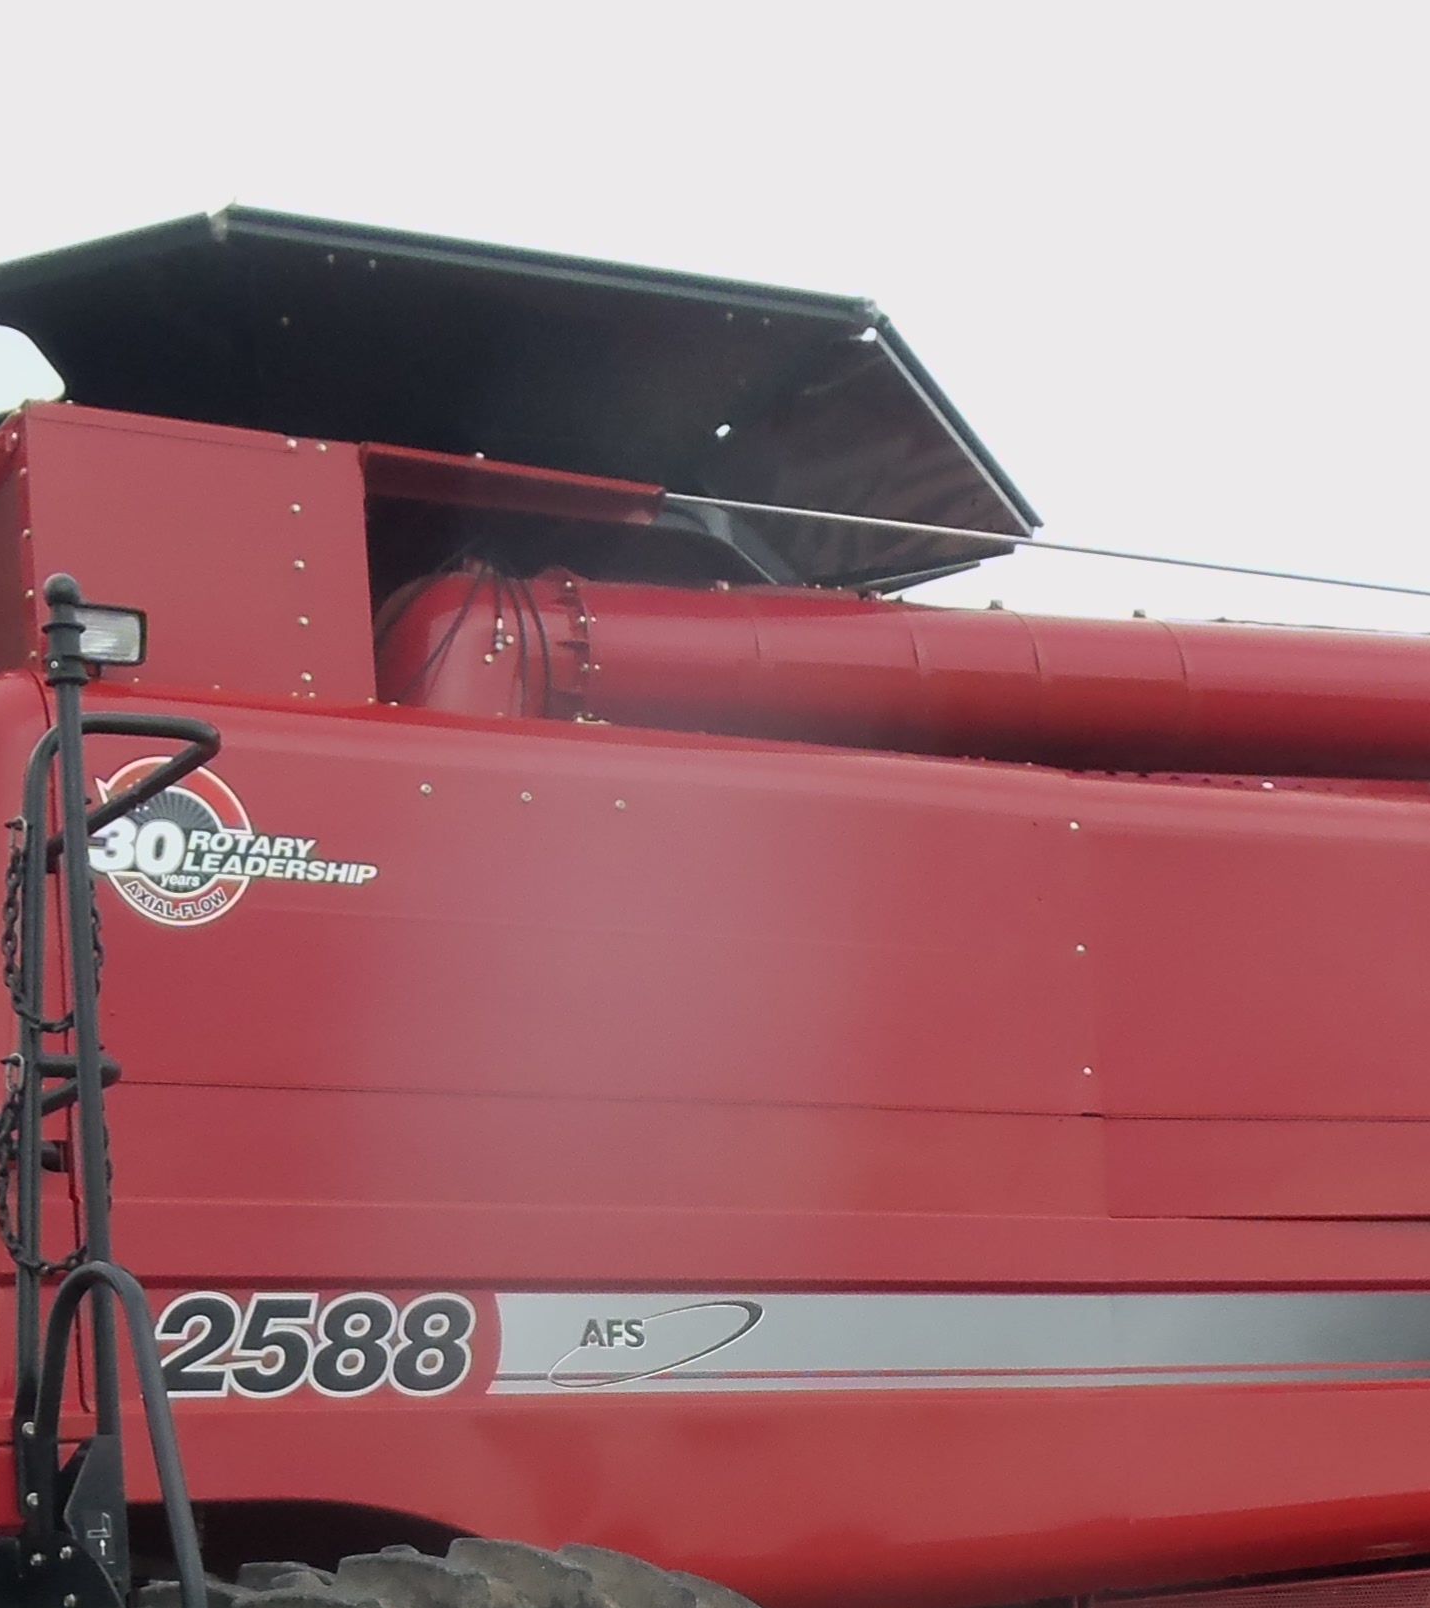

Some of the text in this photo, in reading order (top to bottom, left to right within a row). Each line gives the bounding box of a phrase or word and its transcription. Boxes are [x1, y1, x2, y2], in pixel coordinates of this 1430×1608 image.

[88, 816, 186, 875] 30
[187, 830, 316, 859] ROTARY
[160, 873, 201, 888] years
[182, 852, 378, 884] LEADERSHIP
[123, 881, 227, 918] AXIAL-FLOW
[155, 1291, 475, 1398] 2588
[580, 1318, 645, 1348] AFS
